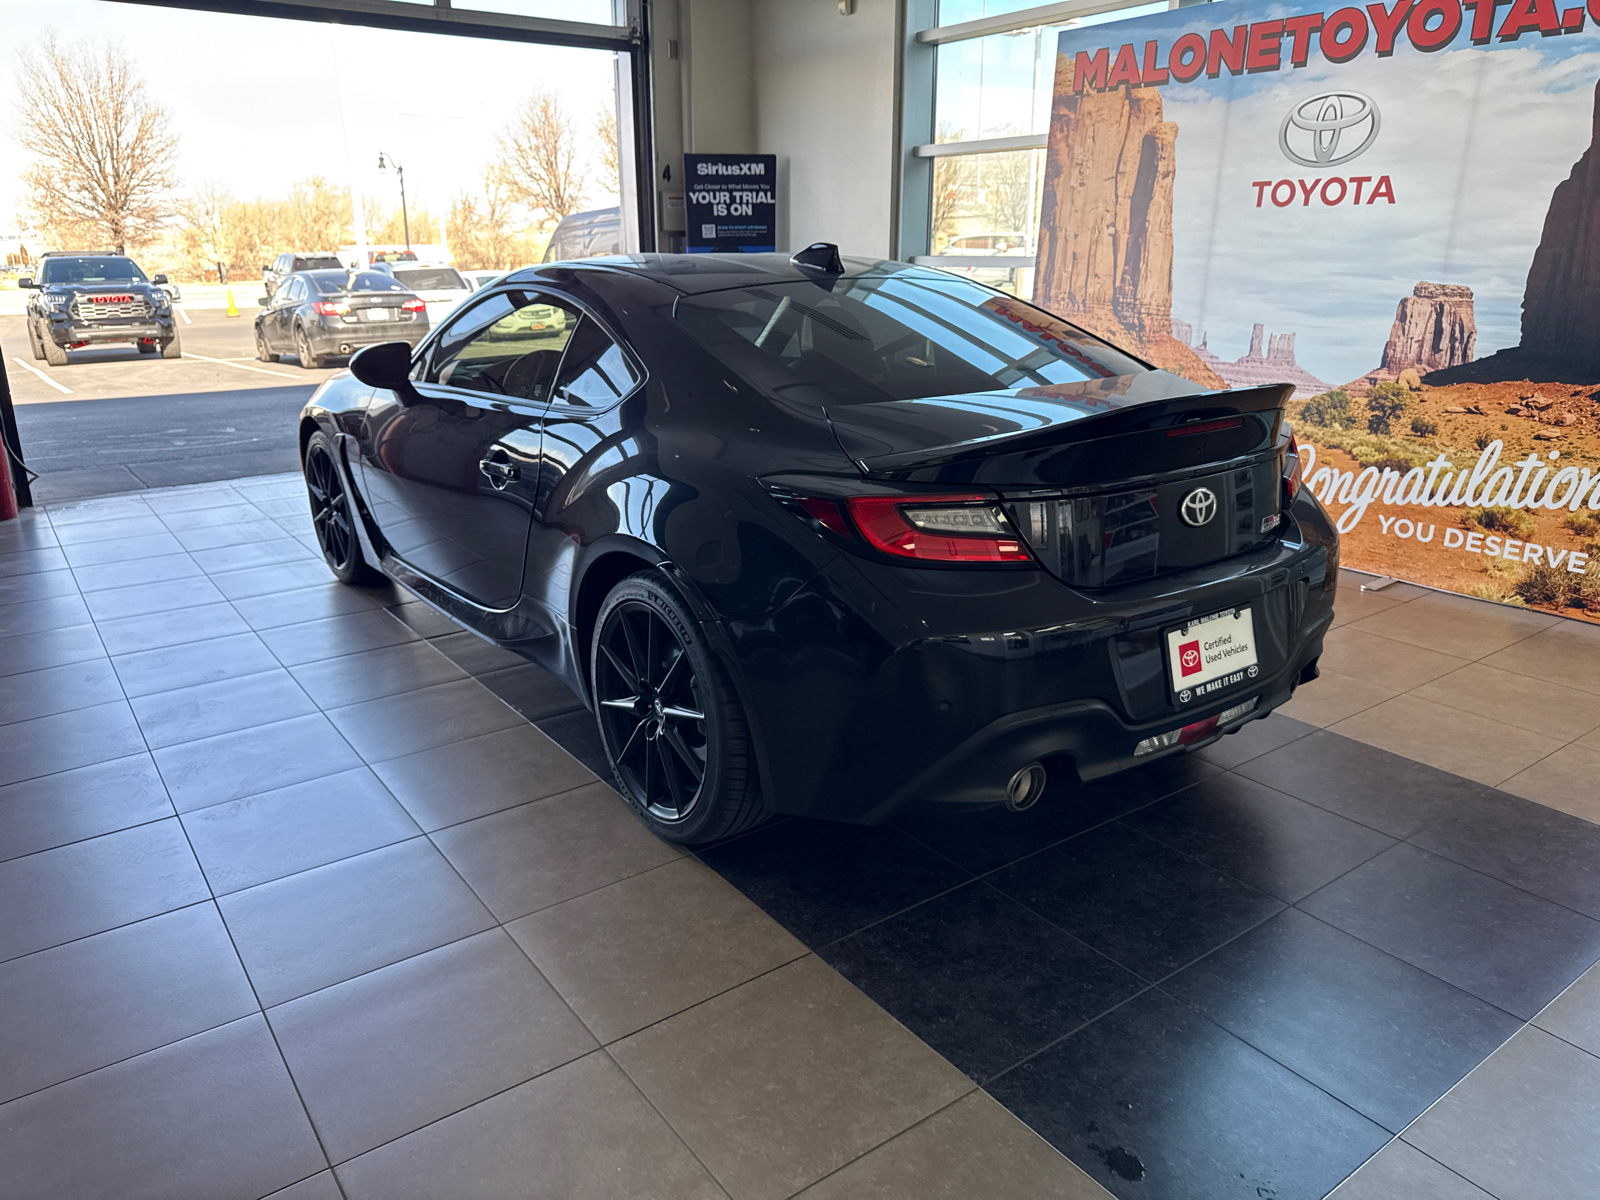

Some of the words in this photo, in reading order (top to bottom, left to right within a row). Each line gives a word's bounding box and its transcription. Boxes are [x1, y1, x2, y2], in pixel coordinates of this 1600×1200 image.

[1073, 0, 1600, 95] MALONETOYOTA.
[663, 164, 671, 182] 4
[697, 163, 765, 175] SiriusXM
[689, 191, 730, 204] YOUR
[732, 191, 776, 204] TRIAL
[1251, 175, 1396, 208] TOYOTA
[713, 204, 728, 216] IS
[730, 204, 753, 216] ON
[91, 295, 132, 303] TOYOTA
[1379, 514, 1435, 543] YOU
[1444, 527, 1588, 574] DESERVE
[656, 597, 692, 642] MICHELIN
[1203, 634, 1232, 651] Certified
[1205, 651, 1222, 664] Used
[1222, 643, 1248, 659] Vehicles
[1195, 685, 1205, 696] WE
[1206, 679, 1222, 692] MAKE
[1223, 677, 1229, 686] IT
[1230, 671, 1244, 684] EASY
